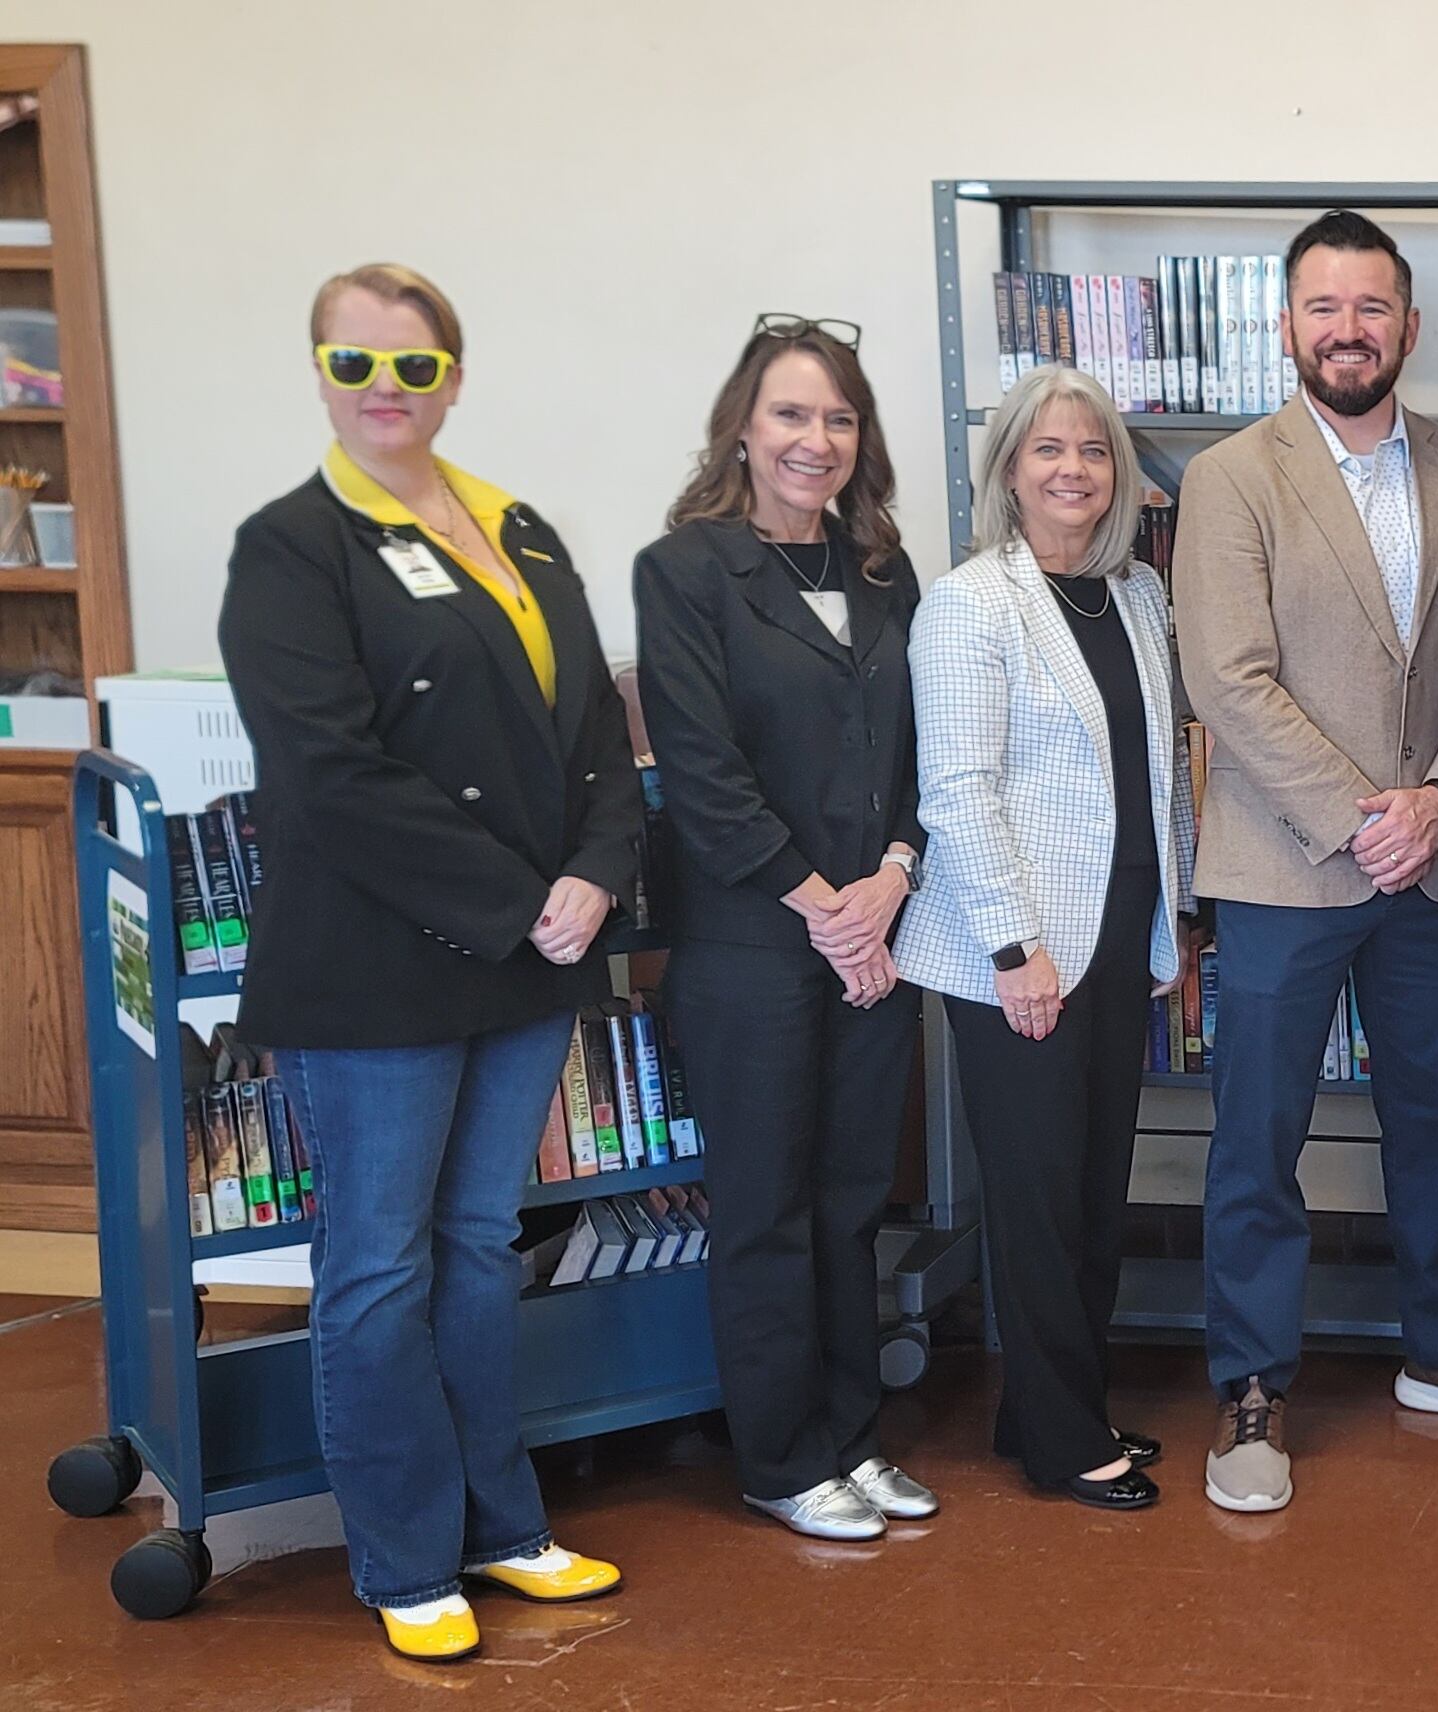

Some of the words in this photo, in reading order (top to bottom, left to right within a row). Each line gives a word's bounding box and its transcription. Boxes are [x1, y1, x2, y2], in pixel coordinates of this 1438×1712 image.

[174, 863, 203, 923] HEARTLES
[209, 861, 238, 920] HEARTLES
[571, 1038, 583, 1076] HARRY
[575, 1078, 590, 1122] POTTER
